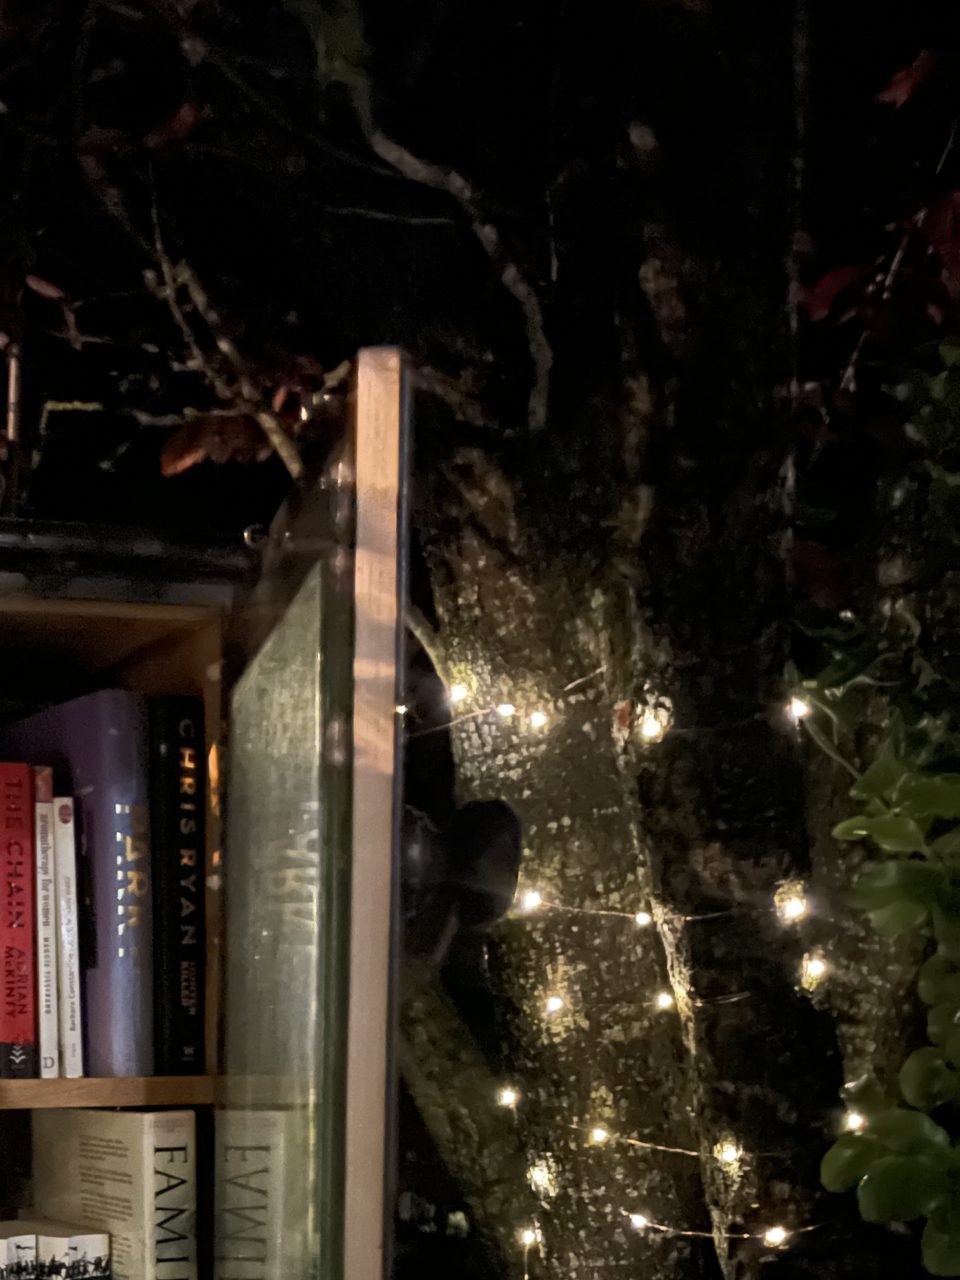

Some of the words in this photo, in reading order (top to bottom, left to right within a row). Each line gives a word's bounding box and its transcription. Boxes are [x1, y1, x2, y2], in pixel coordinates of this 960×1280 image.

[4, 778, 23, 830] THE
[178, 718, 196, 835] CHRIS
[38, 814, 51, 875] aromatherapy
[6, 841, 24, 928] CHAIN
[42, 879, 52, 892] for
[42, 894, 51, 927] women
[179, 849, 197, 946] RYAN
[16, 949, 28, 1014] ADRIAN
